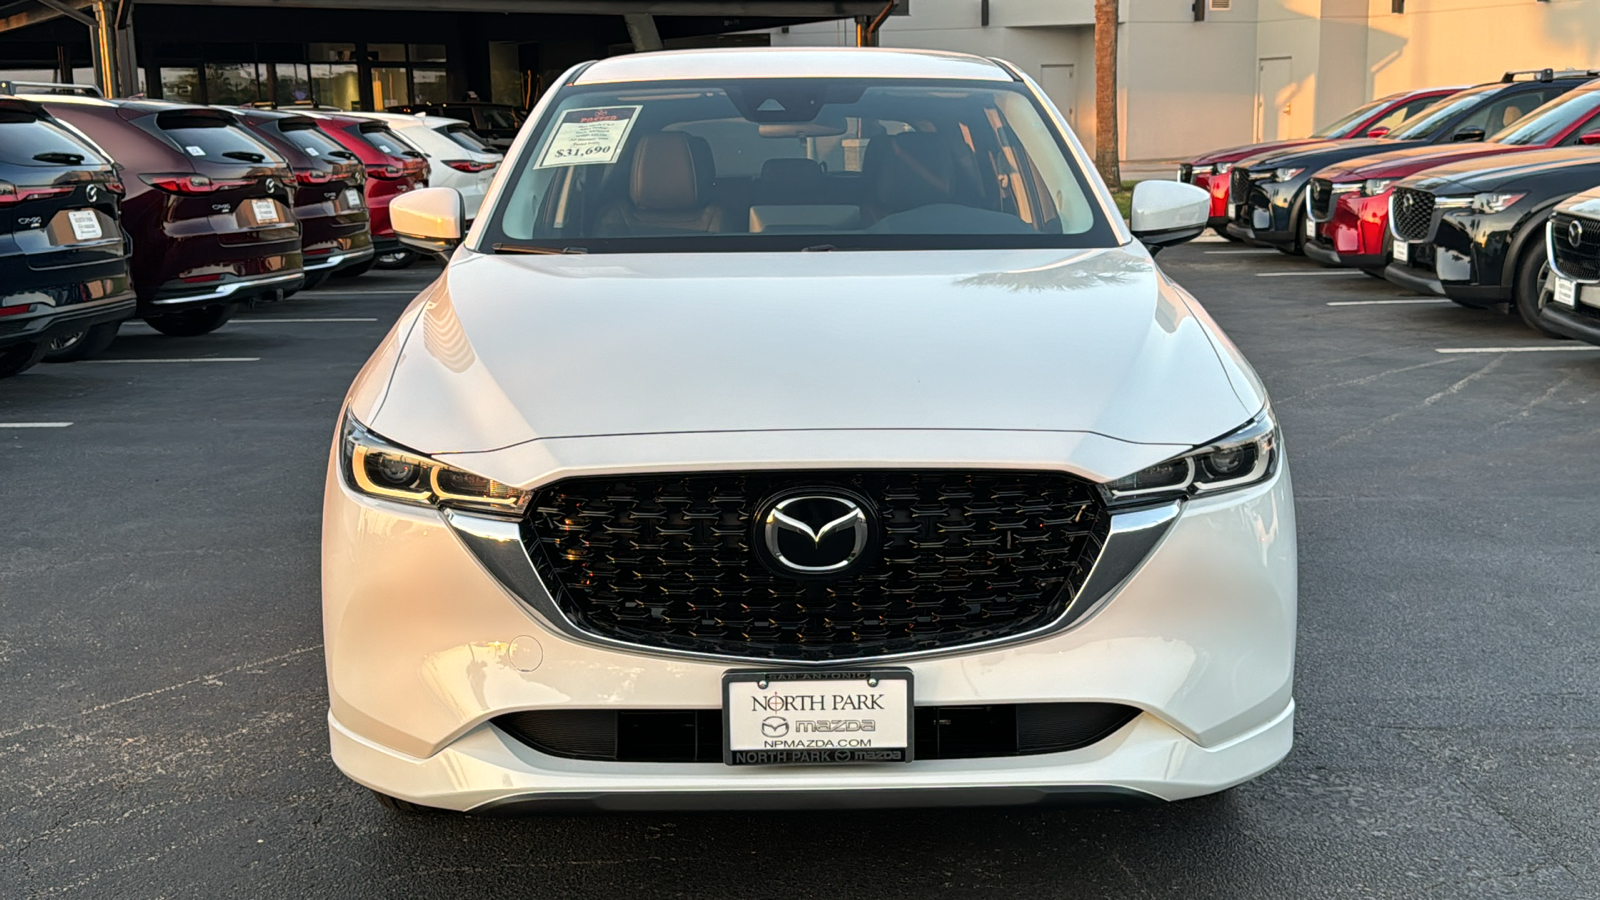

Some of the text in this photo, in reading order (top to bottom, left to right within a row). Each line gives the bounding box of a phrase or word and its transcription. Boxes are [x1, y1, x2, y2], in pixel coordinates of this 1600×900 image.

[555, 146, 611, 158] $31,690
[802, 672, 867, 680] ANTONIO
[751, 694, 885, 712] NORTH PARK
[764, 738, 872, 748] NPMAZDA.COM
[736, 751, 787, 764] NORTH
[792, 750, 831, 762] PARK
